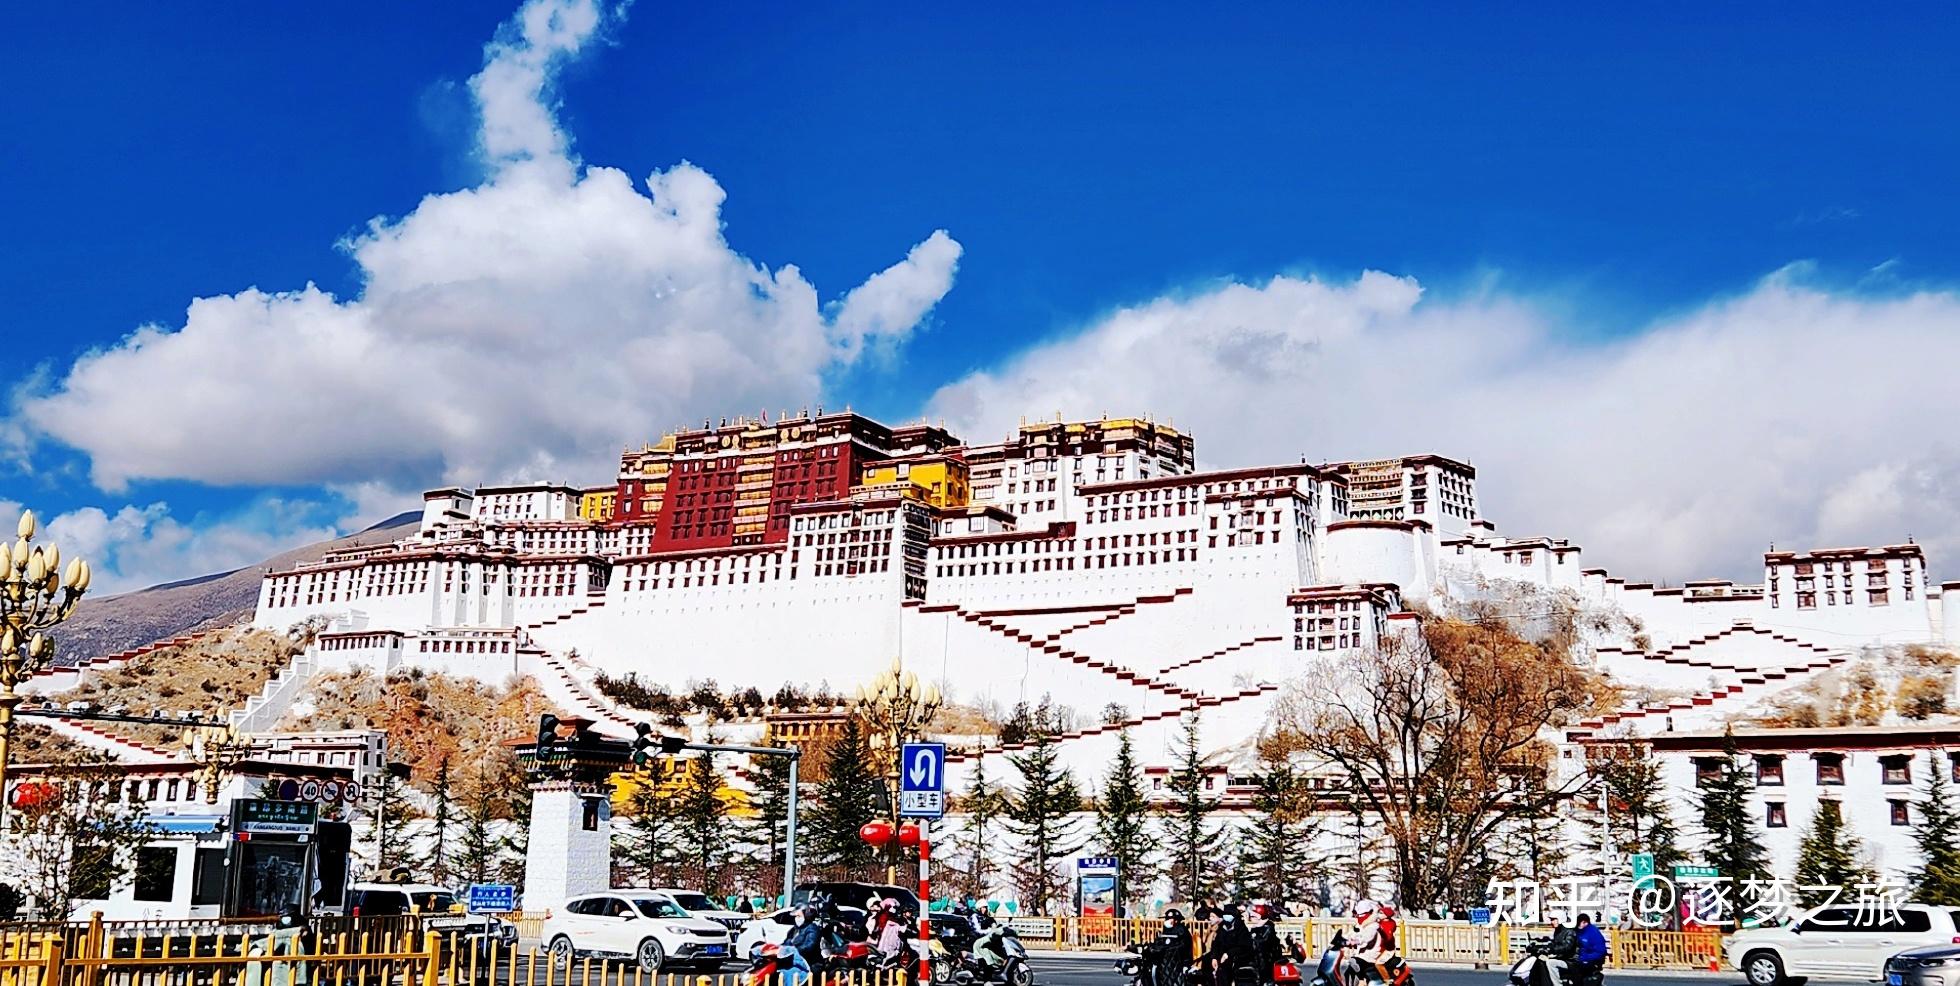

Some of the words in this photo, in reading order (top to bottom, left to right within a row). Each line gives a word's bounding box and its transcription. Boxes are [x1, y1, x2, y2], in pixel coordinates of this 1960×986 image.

[304, 786, 316, 796] 40
[905, 792, 939, 808] 小型车
